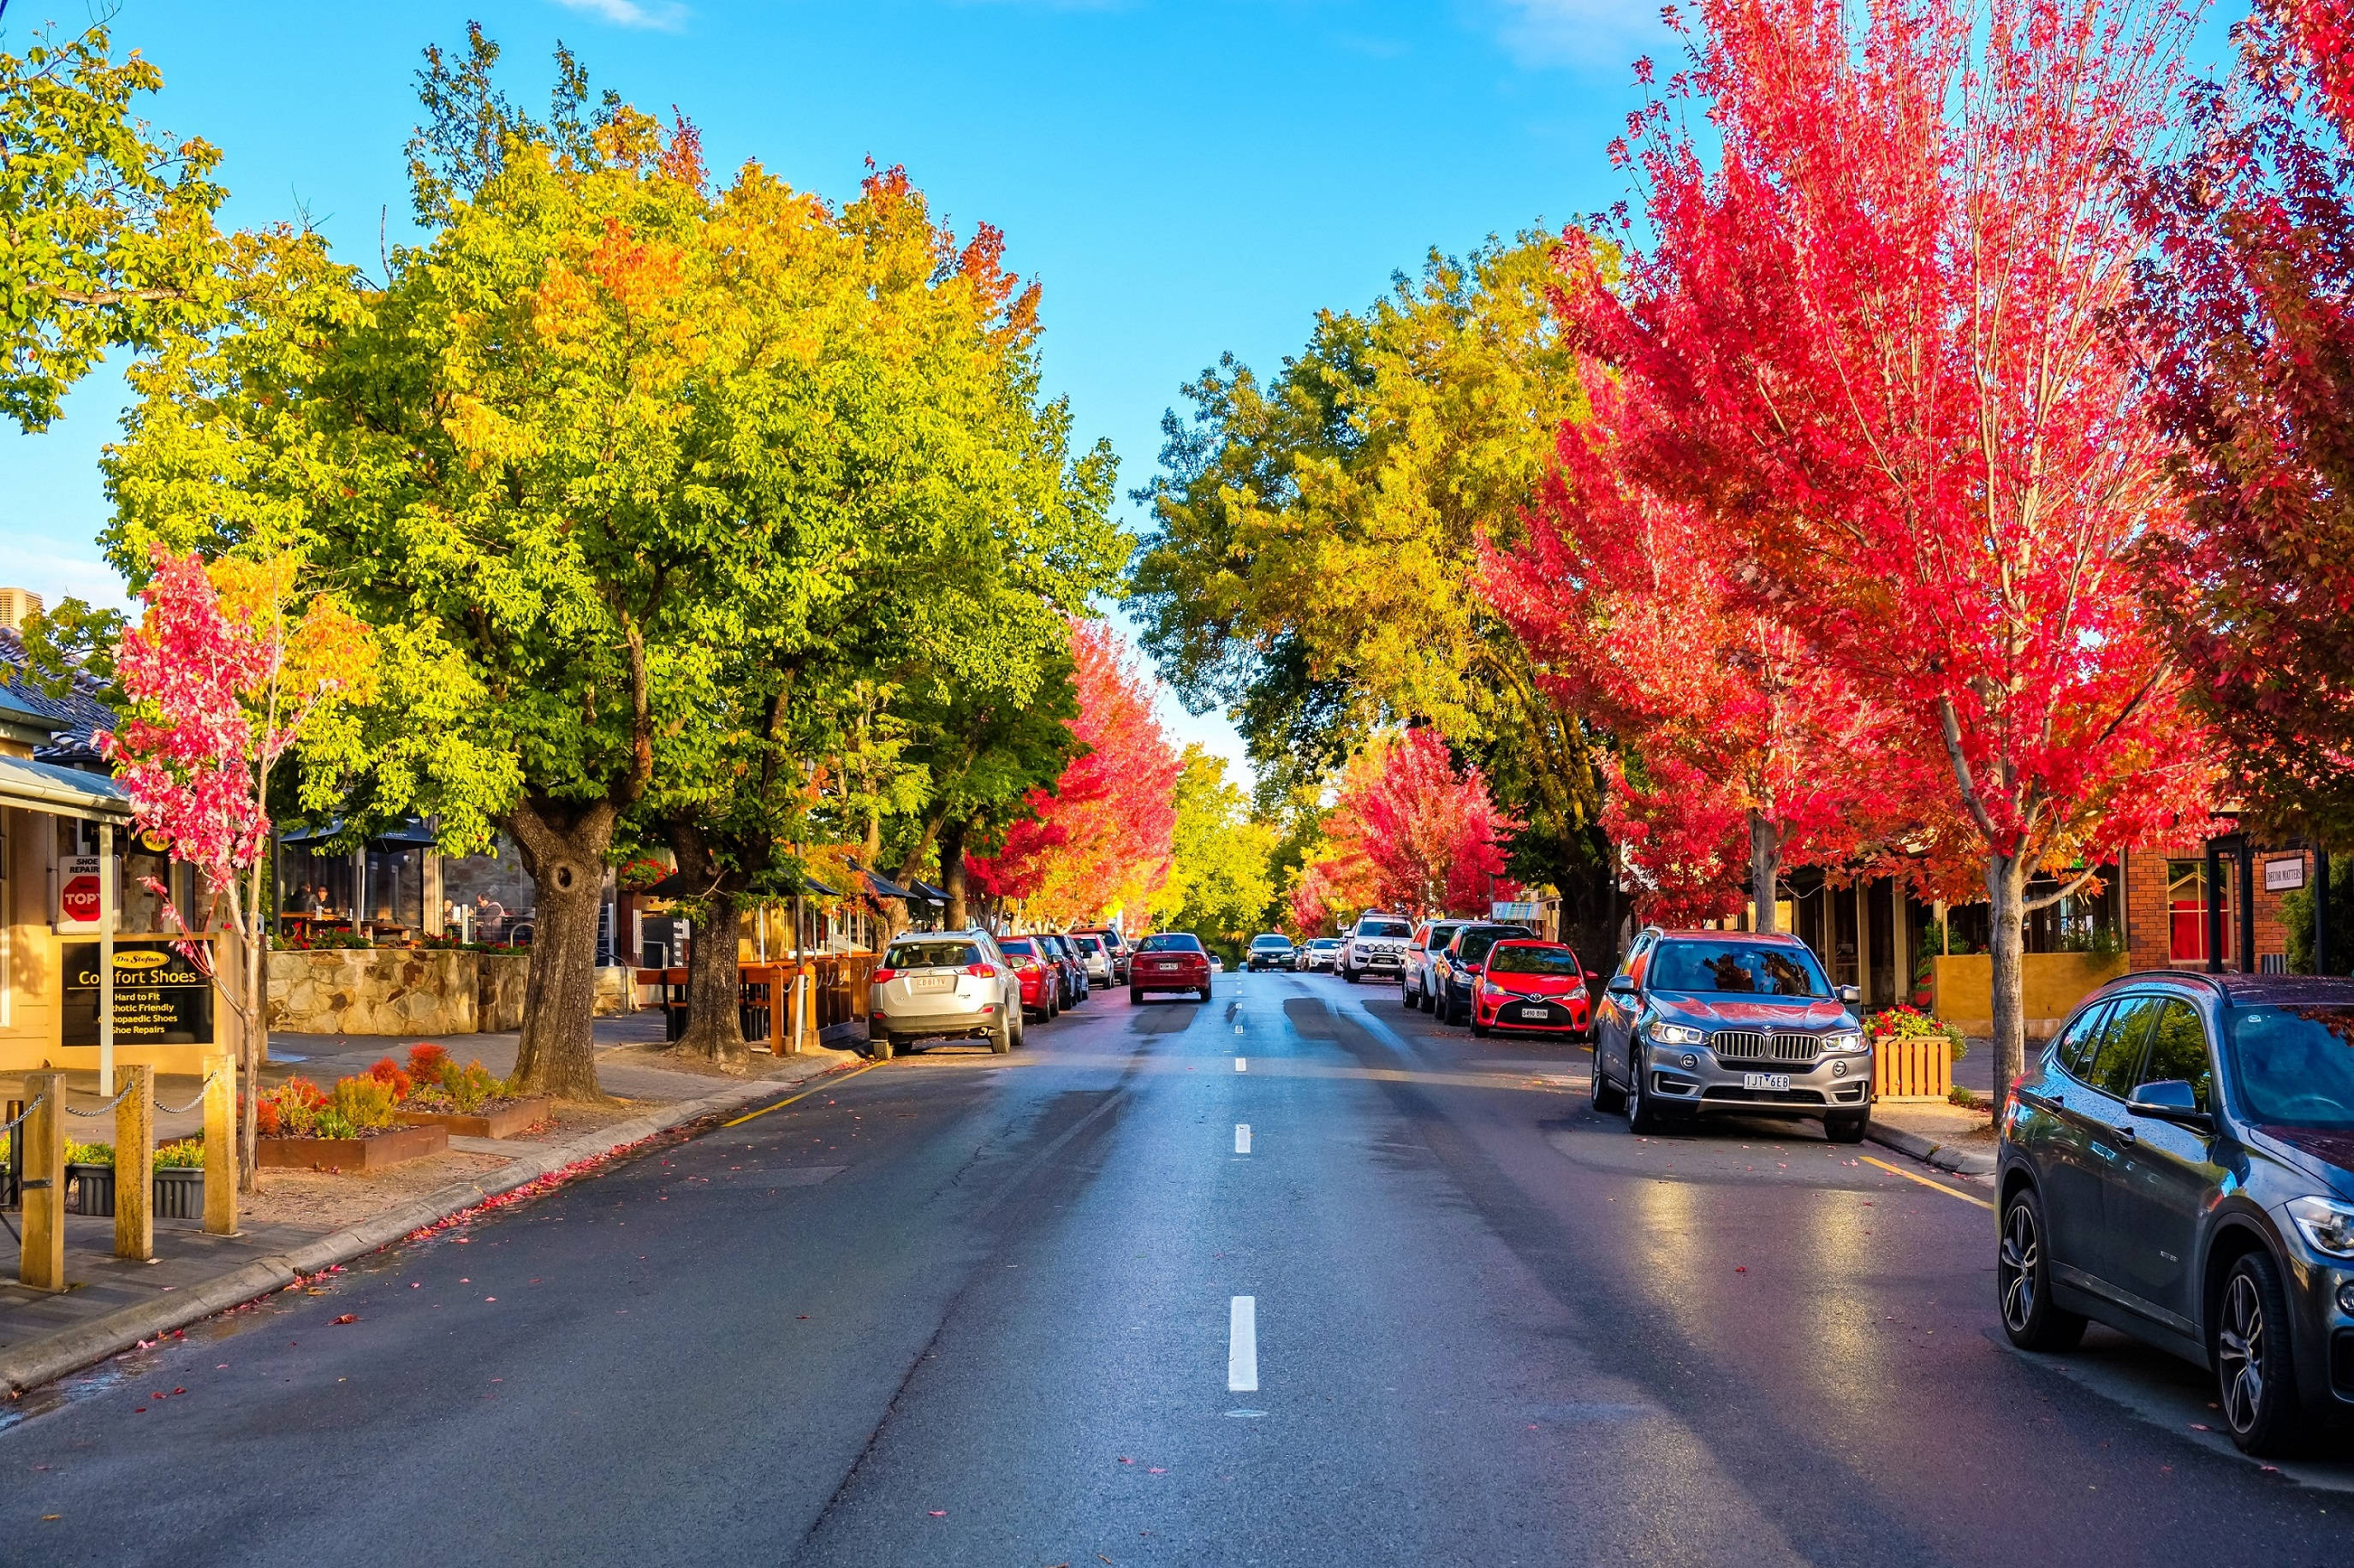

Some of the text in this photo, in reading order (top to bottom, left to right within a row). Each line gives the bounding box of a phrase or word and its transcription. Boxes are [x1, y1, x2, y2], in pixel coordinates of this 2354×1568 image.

[130, 954, 160, 964] Stefan
[79, 970, 196, 984] Cofort Shoes
[115, 993, 135, 1001] Hard
[139, 1004, 175, 1013] Friendly
[152, 1014, 178, 1023] Shoes
[134, 1026, 165, 1035] Repairs
